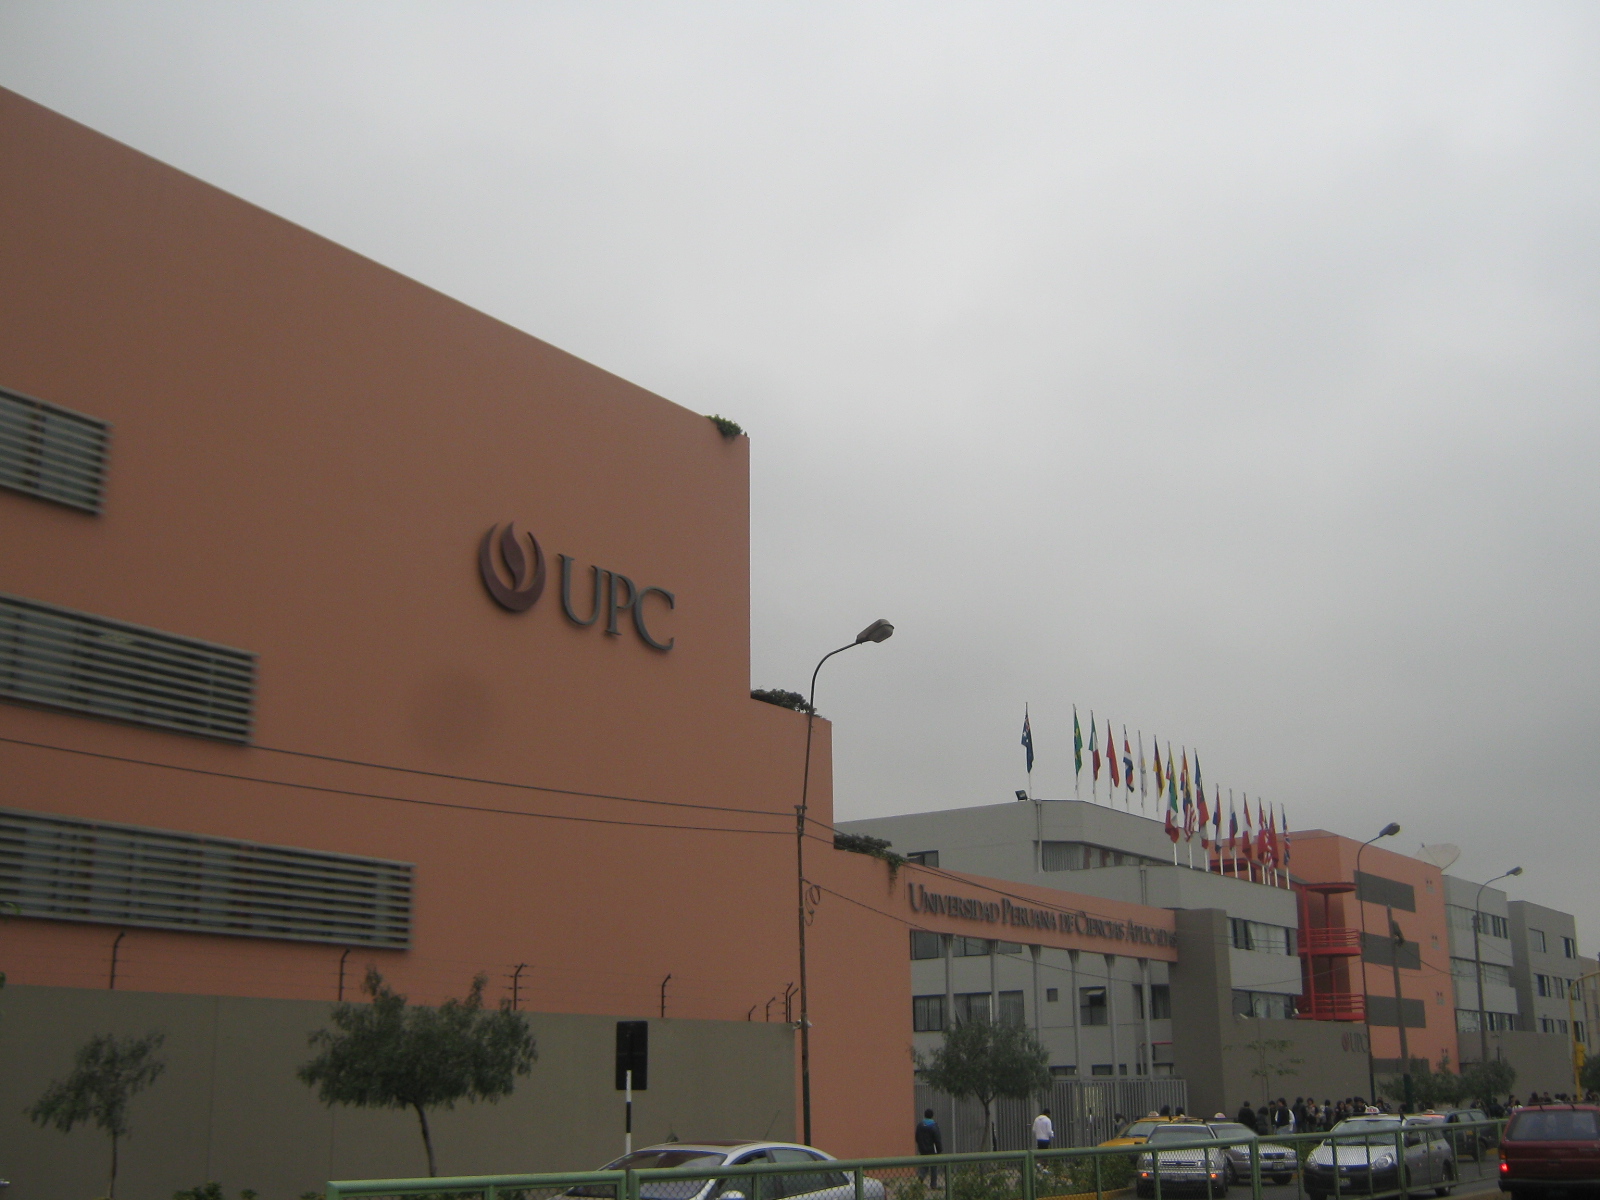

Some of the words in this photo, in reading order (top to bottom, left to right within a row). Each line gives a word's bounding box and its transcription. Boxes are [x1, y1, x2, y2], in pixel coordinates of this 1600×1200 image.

[557, 553, 675, 651] UPC
[908, 882, 1000, 923] UNIVERSIDAD
[1001, 897, 1057, 930] PERUANA
[1059, 913, 1075, 933] DE
